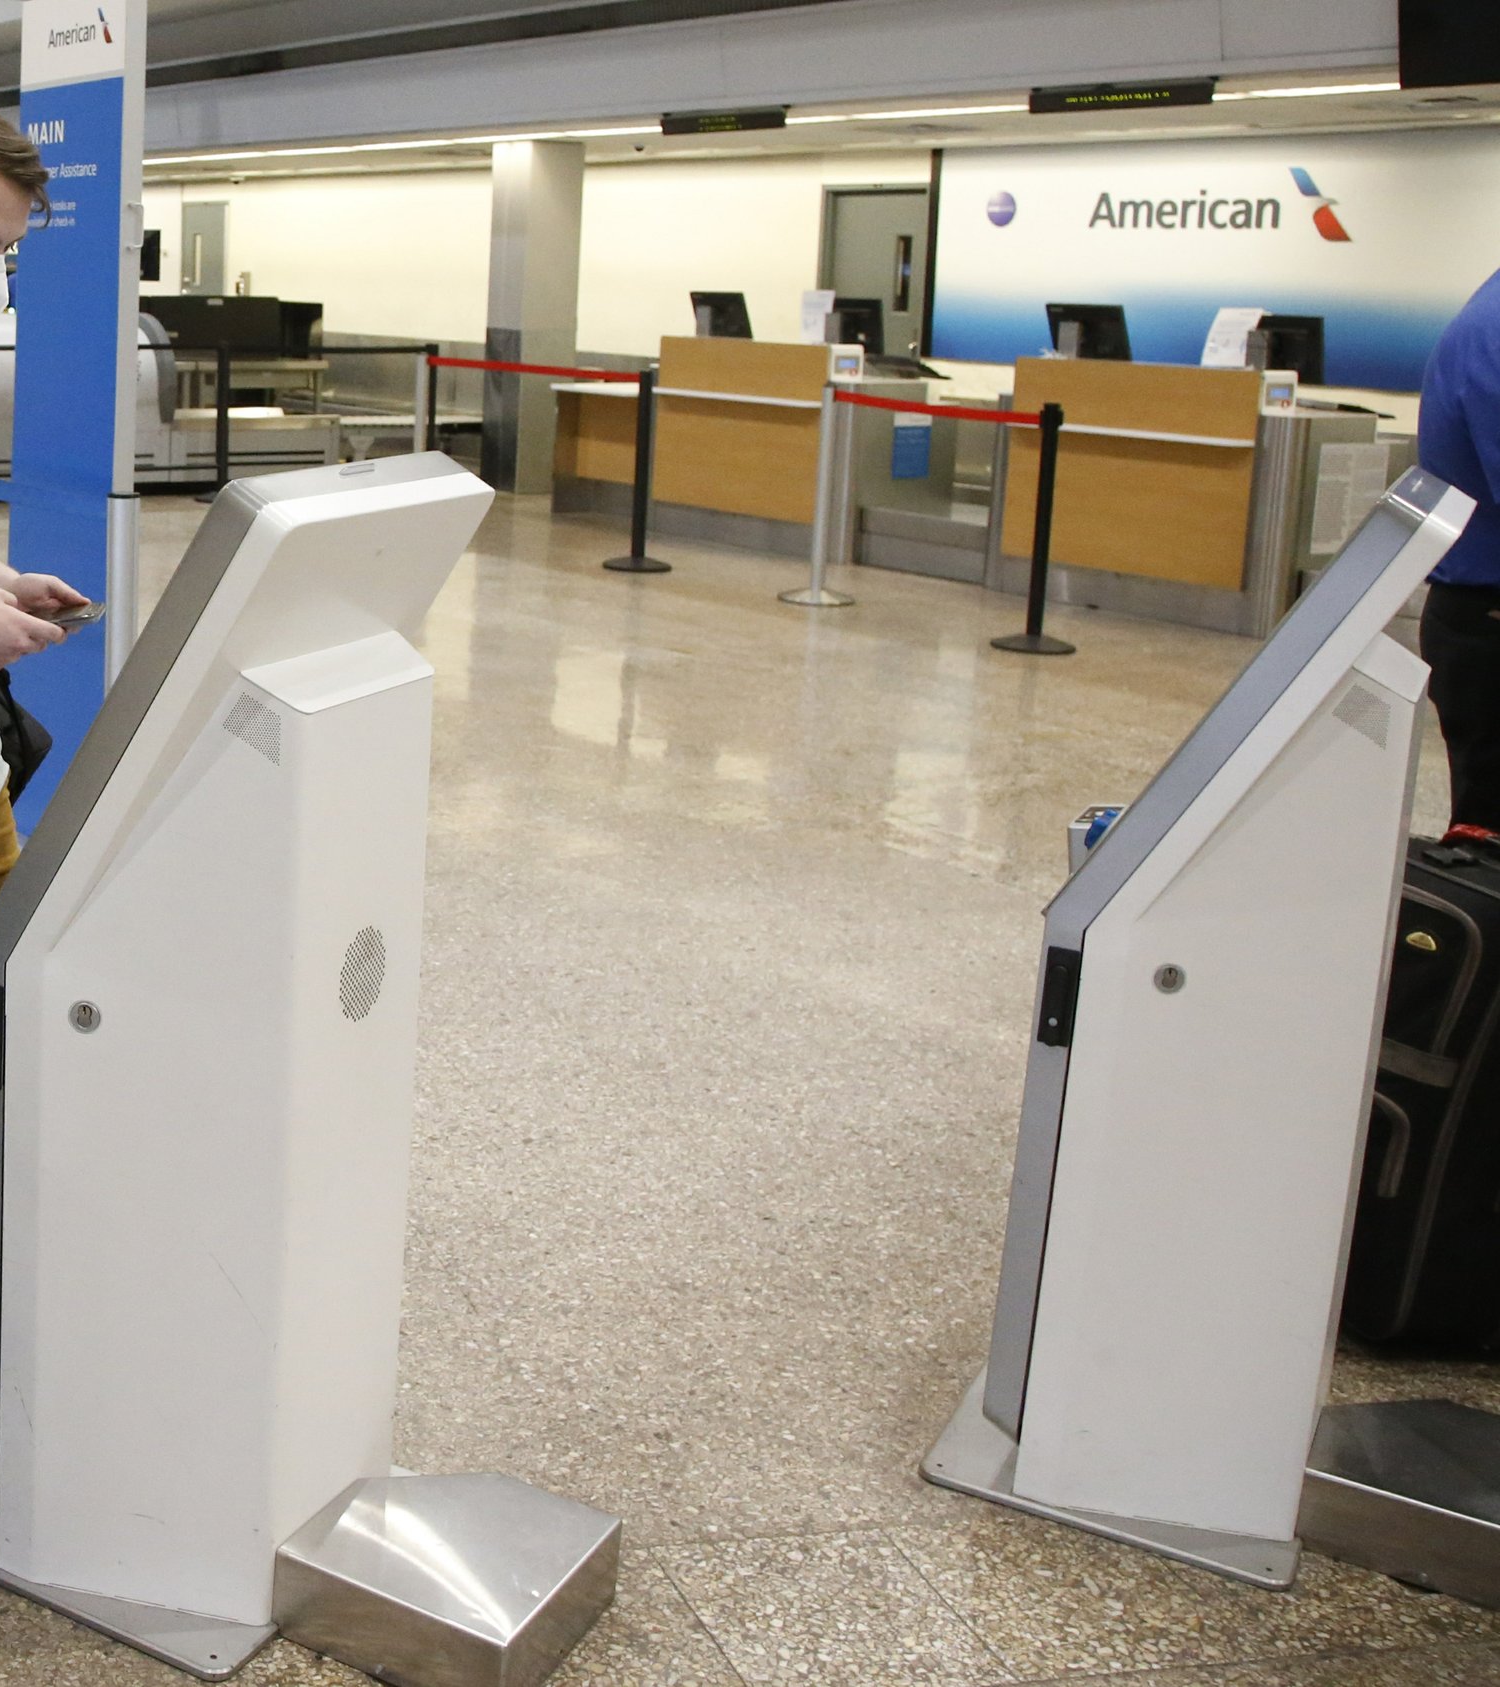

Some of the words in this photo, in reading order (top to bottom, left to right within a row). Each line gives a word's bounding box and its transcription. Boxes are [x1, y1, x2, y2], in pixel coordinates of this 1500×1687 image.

[48, 23, 96, 48] American
[28, 119, 65, 145] MAIN
[60, 162, 97, 178] Assistance
[1088, 189, 1280, 229] American
